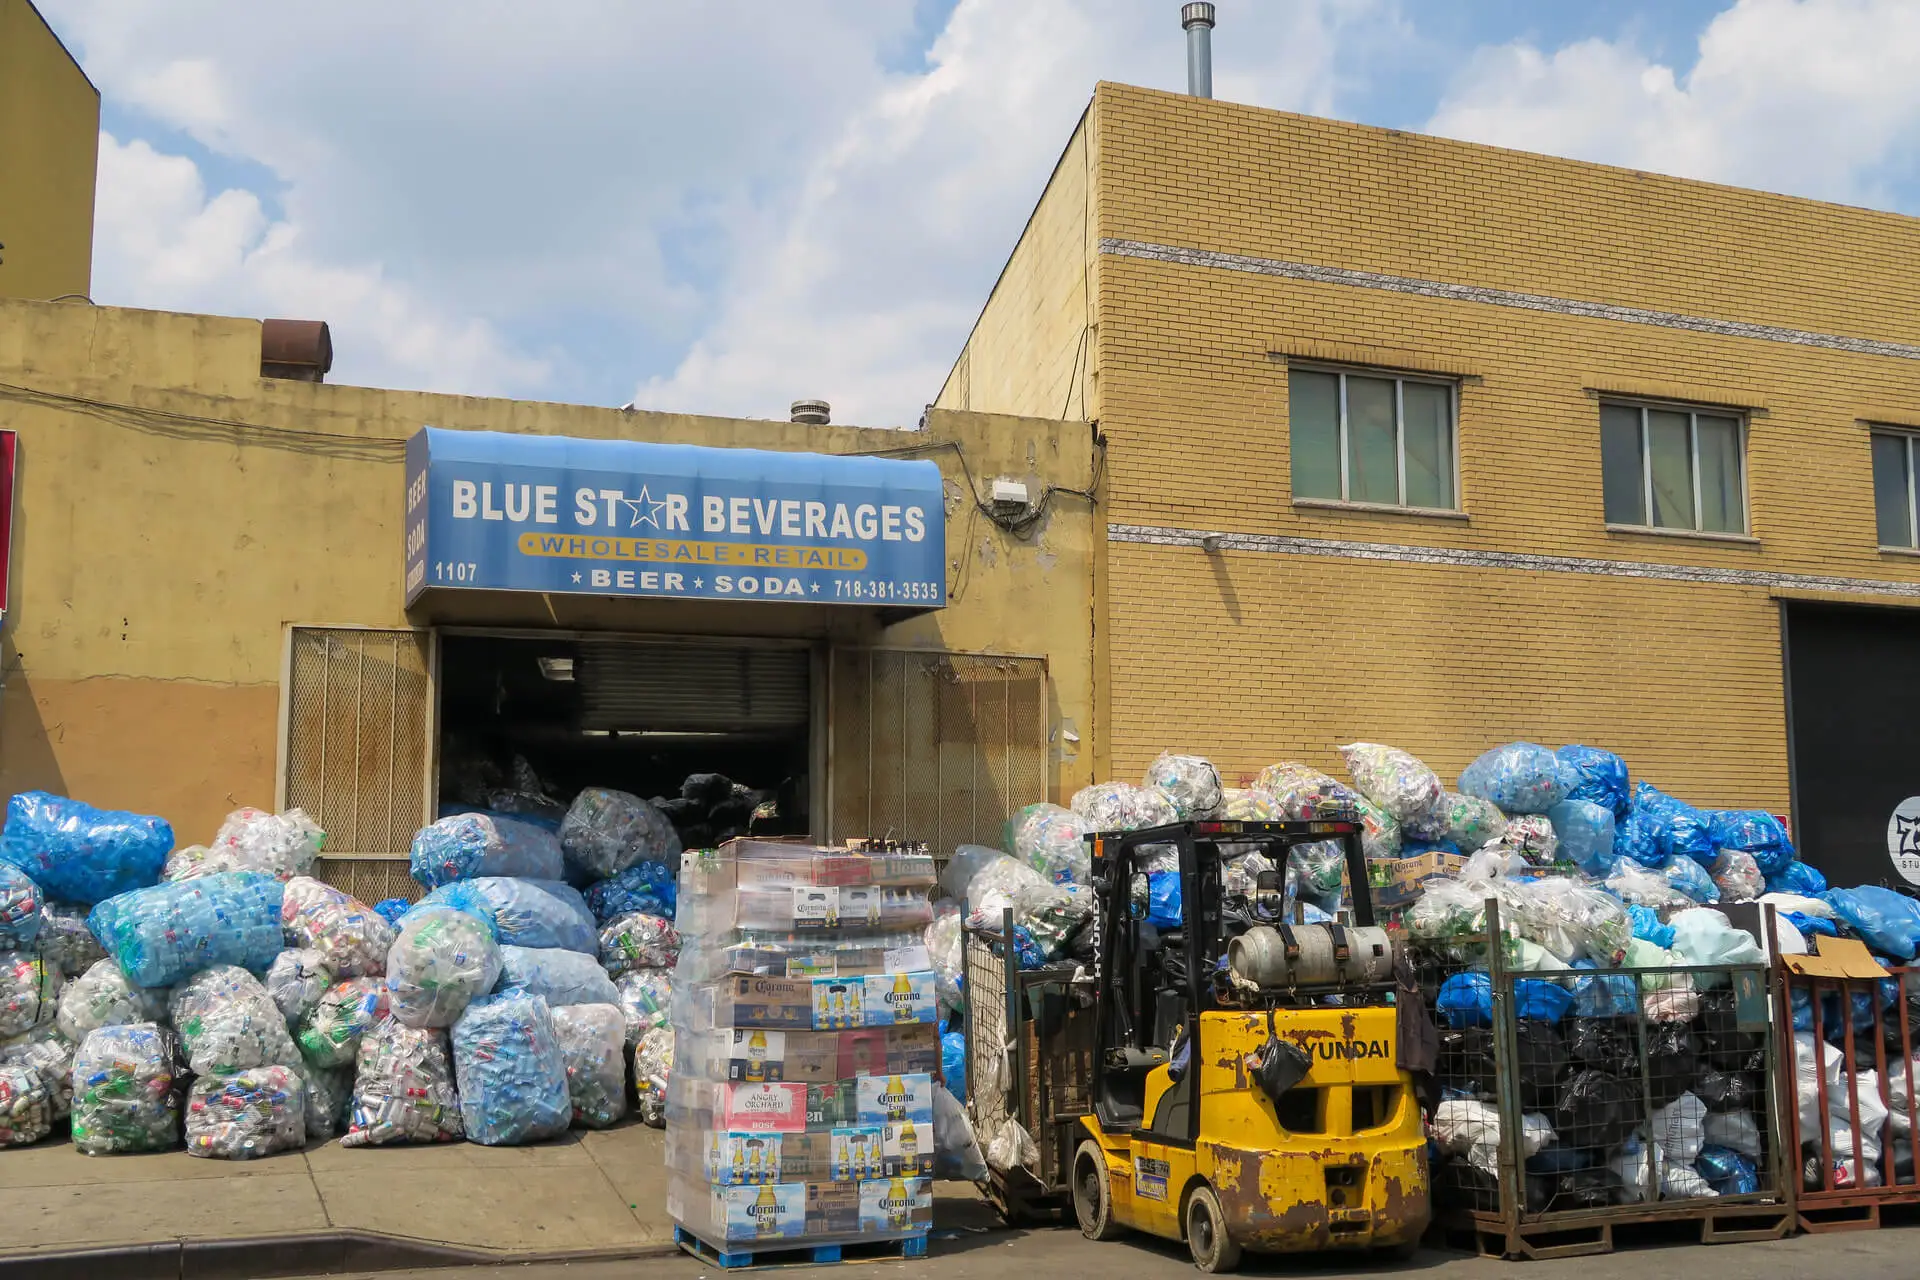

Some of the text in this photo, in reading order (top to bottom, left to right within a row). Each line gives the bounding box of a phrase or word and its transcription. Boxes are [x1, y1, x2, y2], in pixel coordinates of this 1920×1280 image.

[408, 469, 426, 514] BEER
[453, 480, 558, 523] BLUE
[703, 495, 926, 542] BEVERAGES
[408, 519, 425, 560] SODA
[540, 537, 851, 567] WHOLESALE RETAIL
[435, 561, 477, 581] 1107
[591, 569, 805, 596] BEER SODA
[834, 580, 938, 600] 718-381-3535
[755, 980, 795, 993] Corona
[884, 991, 921, 1005] Corona
[1303, 1039, 1389, 1061] YUNDAI
[877, 1093, 914, 1105] Corona
[746, 1203, 786, 1217] Corona
[879, 1197, 916, 1210] Corona
